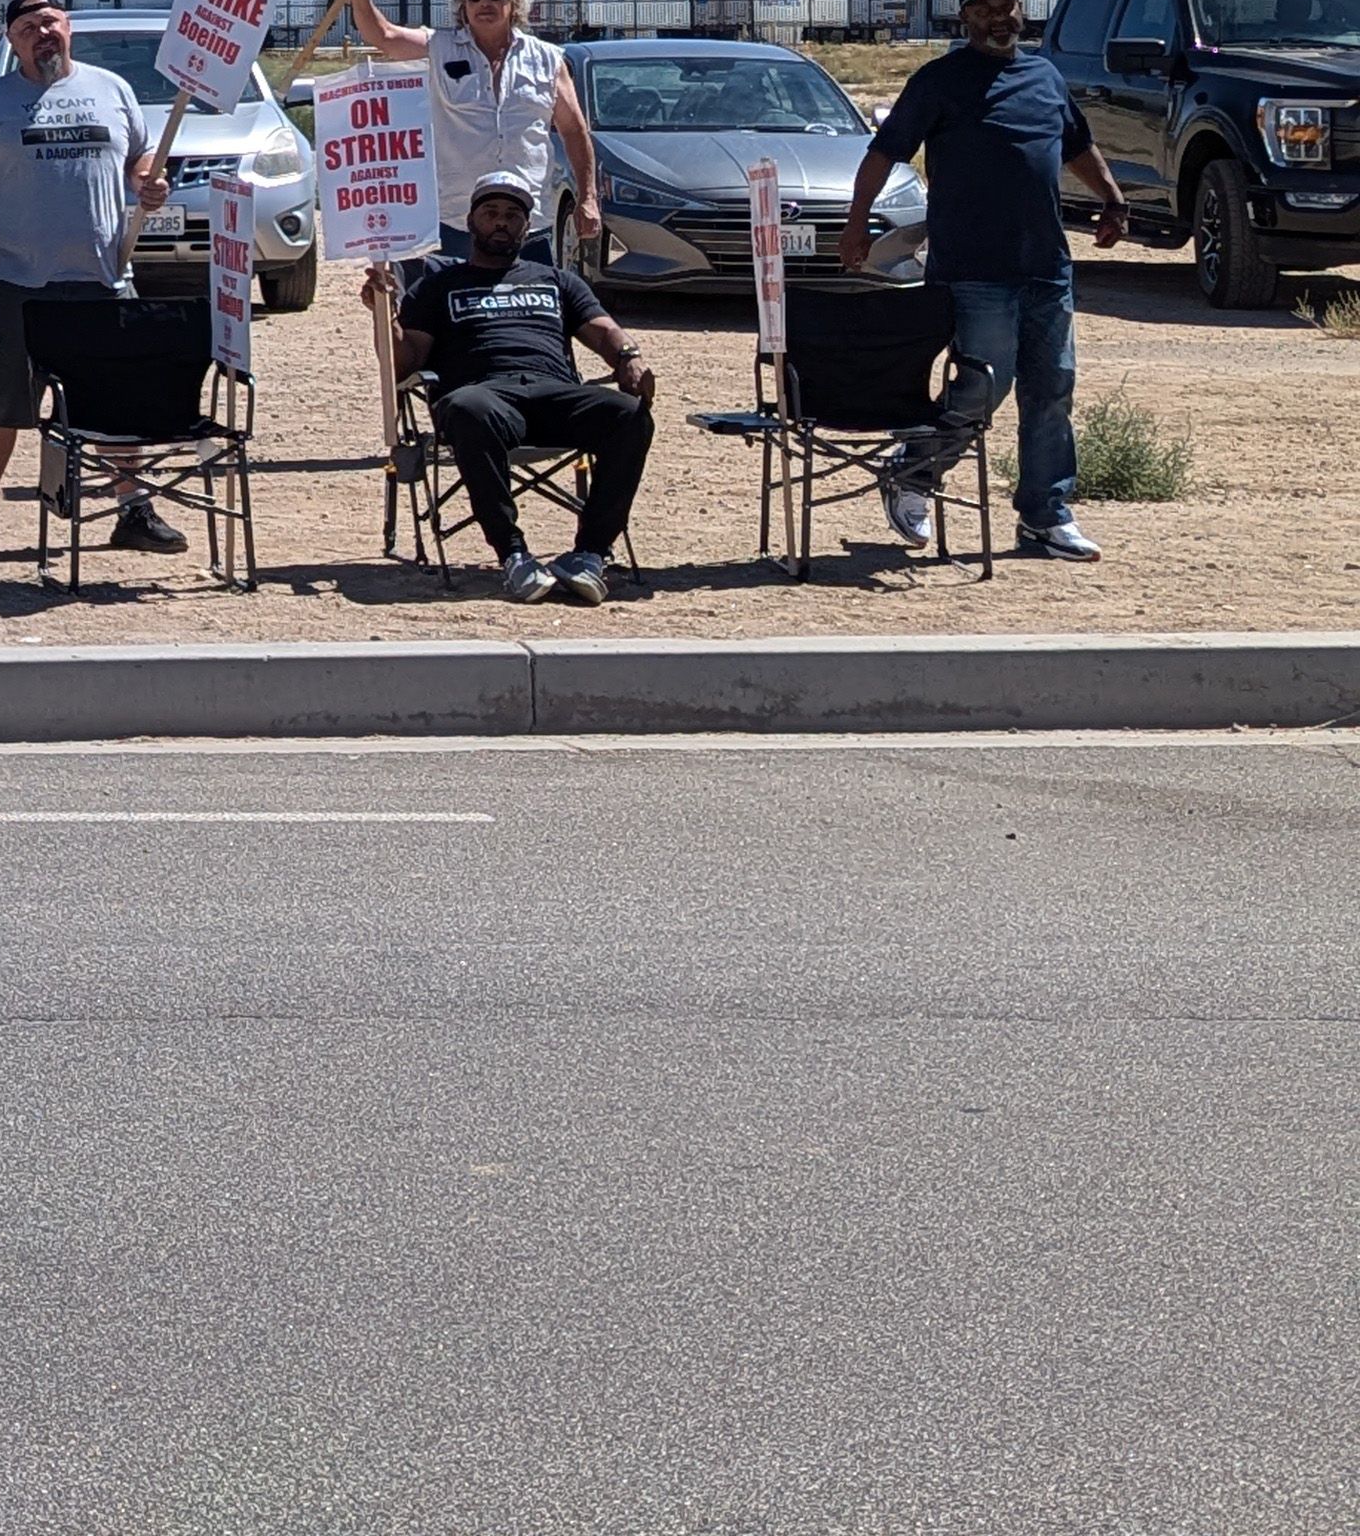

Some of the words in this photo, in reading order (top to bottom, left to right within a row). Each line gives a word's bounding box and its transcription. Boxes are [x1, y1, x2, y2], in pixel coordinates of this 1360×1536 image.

[178, 11, 241, 65] Boeing
[21, 100, 52, 112] YOU
[350, 96, 390, 130] ON
[29, 114, 71, 125] SCARE
[44, 130, 49, 141] I
[52, 128, 90, 141] HAVE
[36, 148, 43, 160] A
[324, 129, 425, 170] STRIKE
[350, 166, 399, 184] AGAINST
[337, 181, 419, 212] Boeing
[213, 233, 250, 275] STRIKE
[454, 293, 555, 312] LEGENDS
